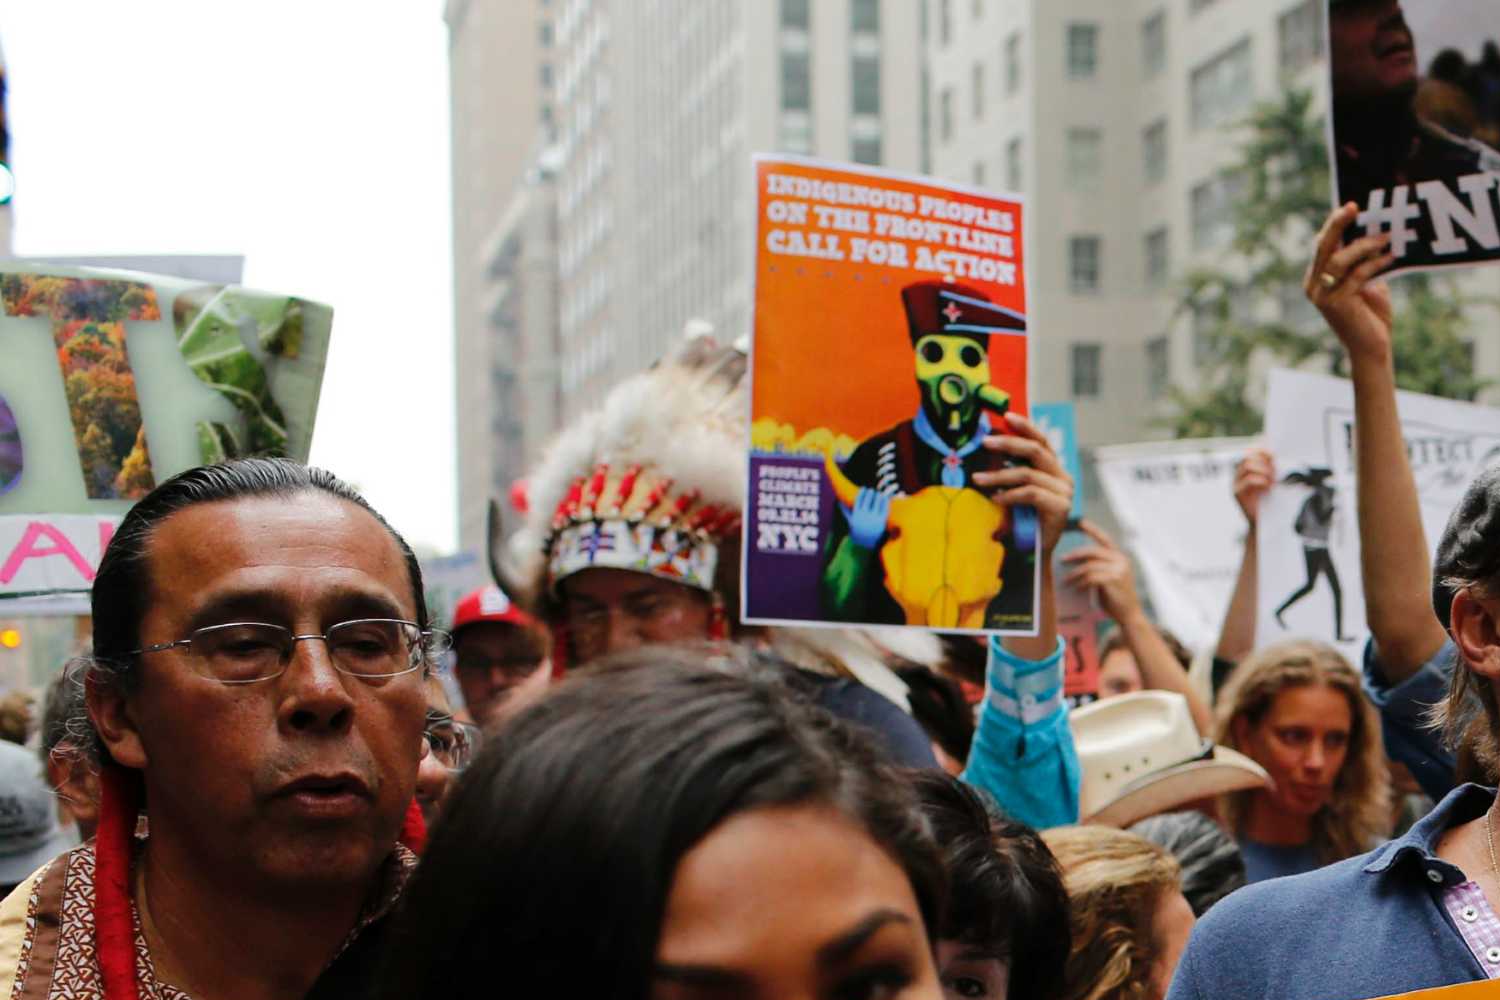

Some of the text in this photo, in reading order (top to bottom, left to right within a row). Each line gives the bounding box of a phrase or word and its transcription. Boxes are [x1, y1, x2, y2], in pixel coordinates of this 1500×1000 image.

[767, 174, 1014, 232] INDIGENOUS PEOPLES
[767, 201, 1014, 257] ON THE FRONTLINE
[767, 230, 1016, 285] CALL FOR ACTION
[757, 522, 819, 553] NYC
